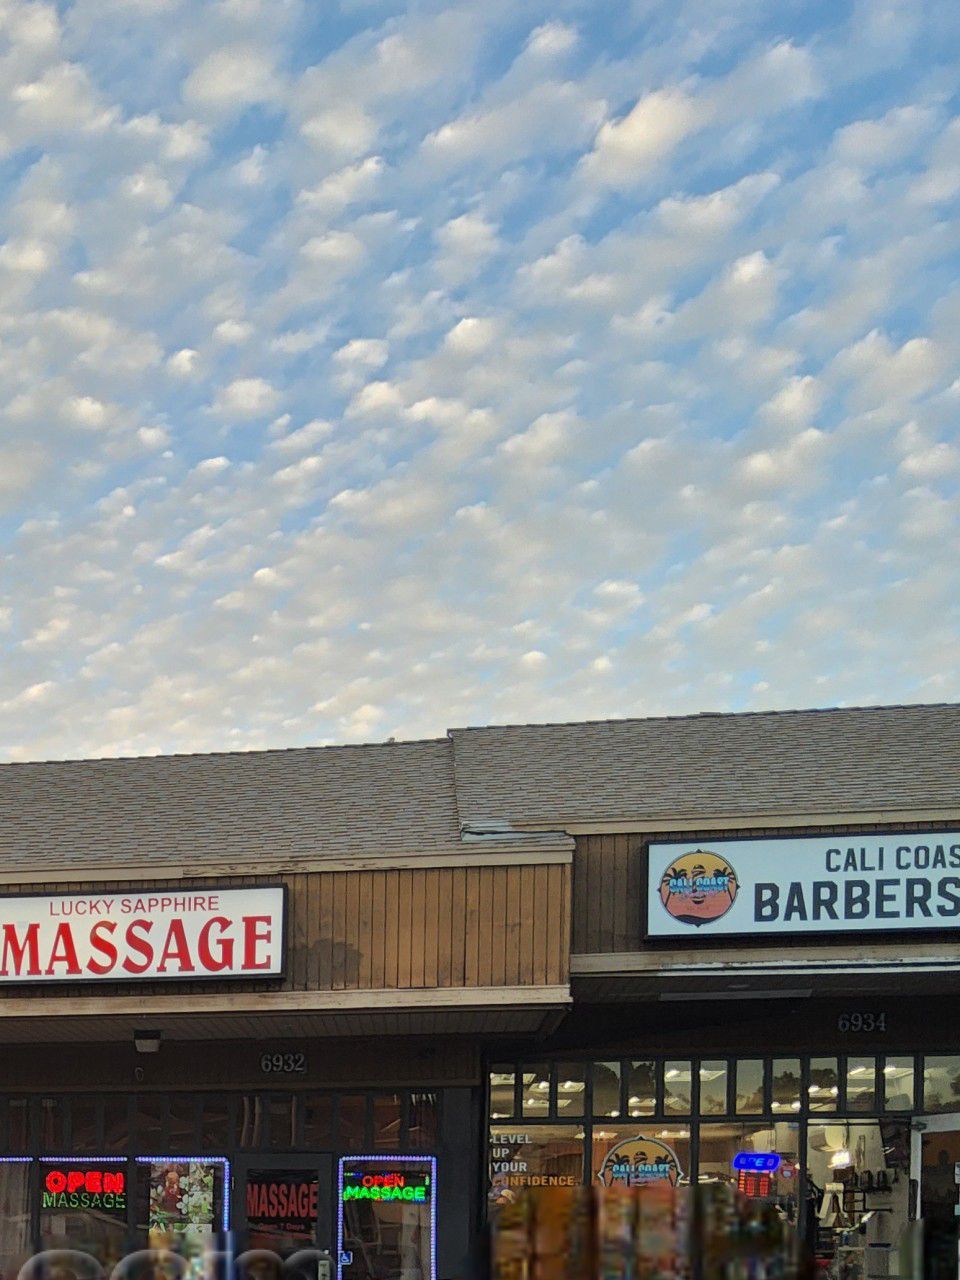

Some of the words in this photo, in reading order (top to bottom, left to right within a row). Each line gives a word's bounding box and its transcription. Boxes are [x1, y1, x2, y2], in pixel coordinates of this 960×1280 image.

[825, 847, 884, 872] CALI
[50, 899, 115, 917] LUCKY
[120, 895, 220, 914] SAPPHIRE
[753, 876, 960, 922] BARBERS
[839, 1012, 887, 1032] 6934
[261, 1052, 305, 1072] 6932
[492, 1134, 533, 1144] LEVEL
[492, 1148, 510, 1158] UP
[492, 1161, 528, 1172] YOUR
[45, 1170, 125, 1193] OPEN
[362, 1175, 405, 1187] OPEN
[42, 1191, 126, 1208] MASSAGE
[246, 1183, 319, 1218] MASSAGE
[345, 1185, 426, 1200] MASSAGE
